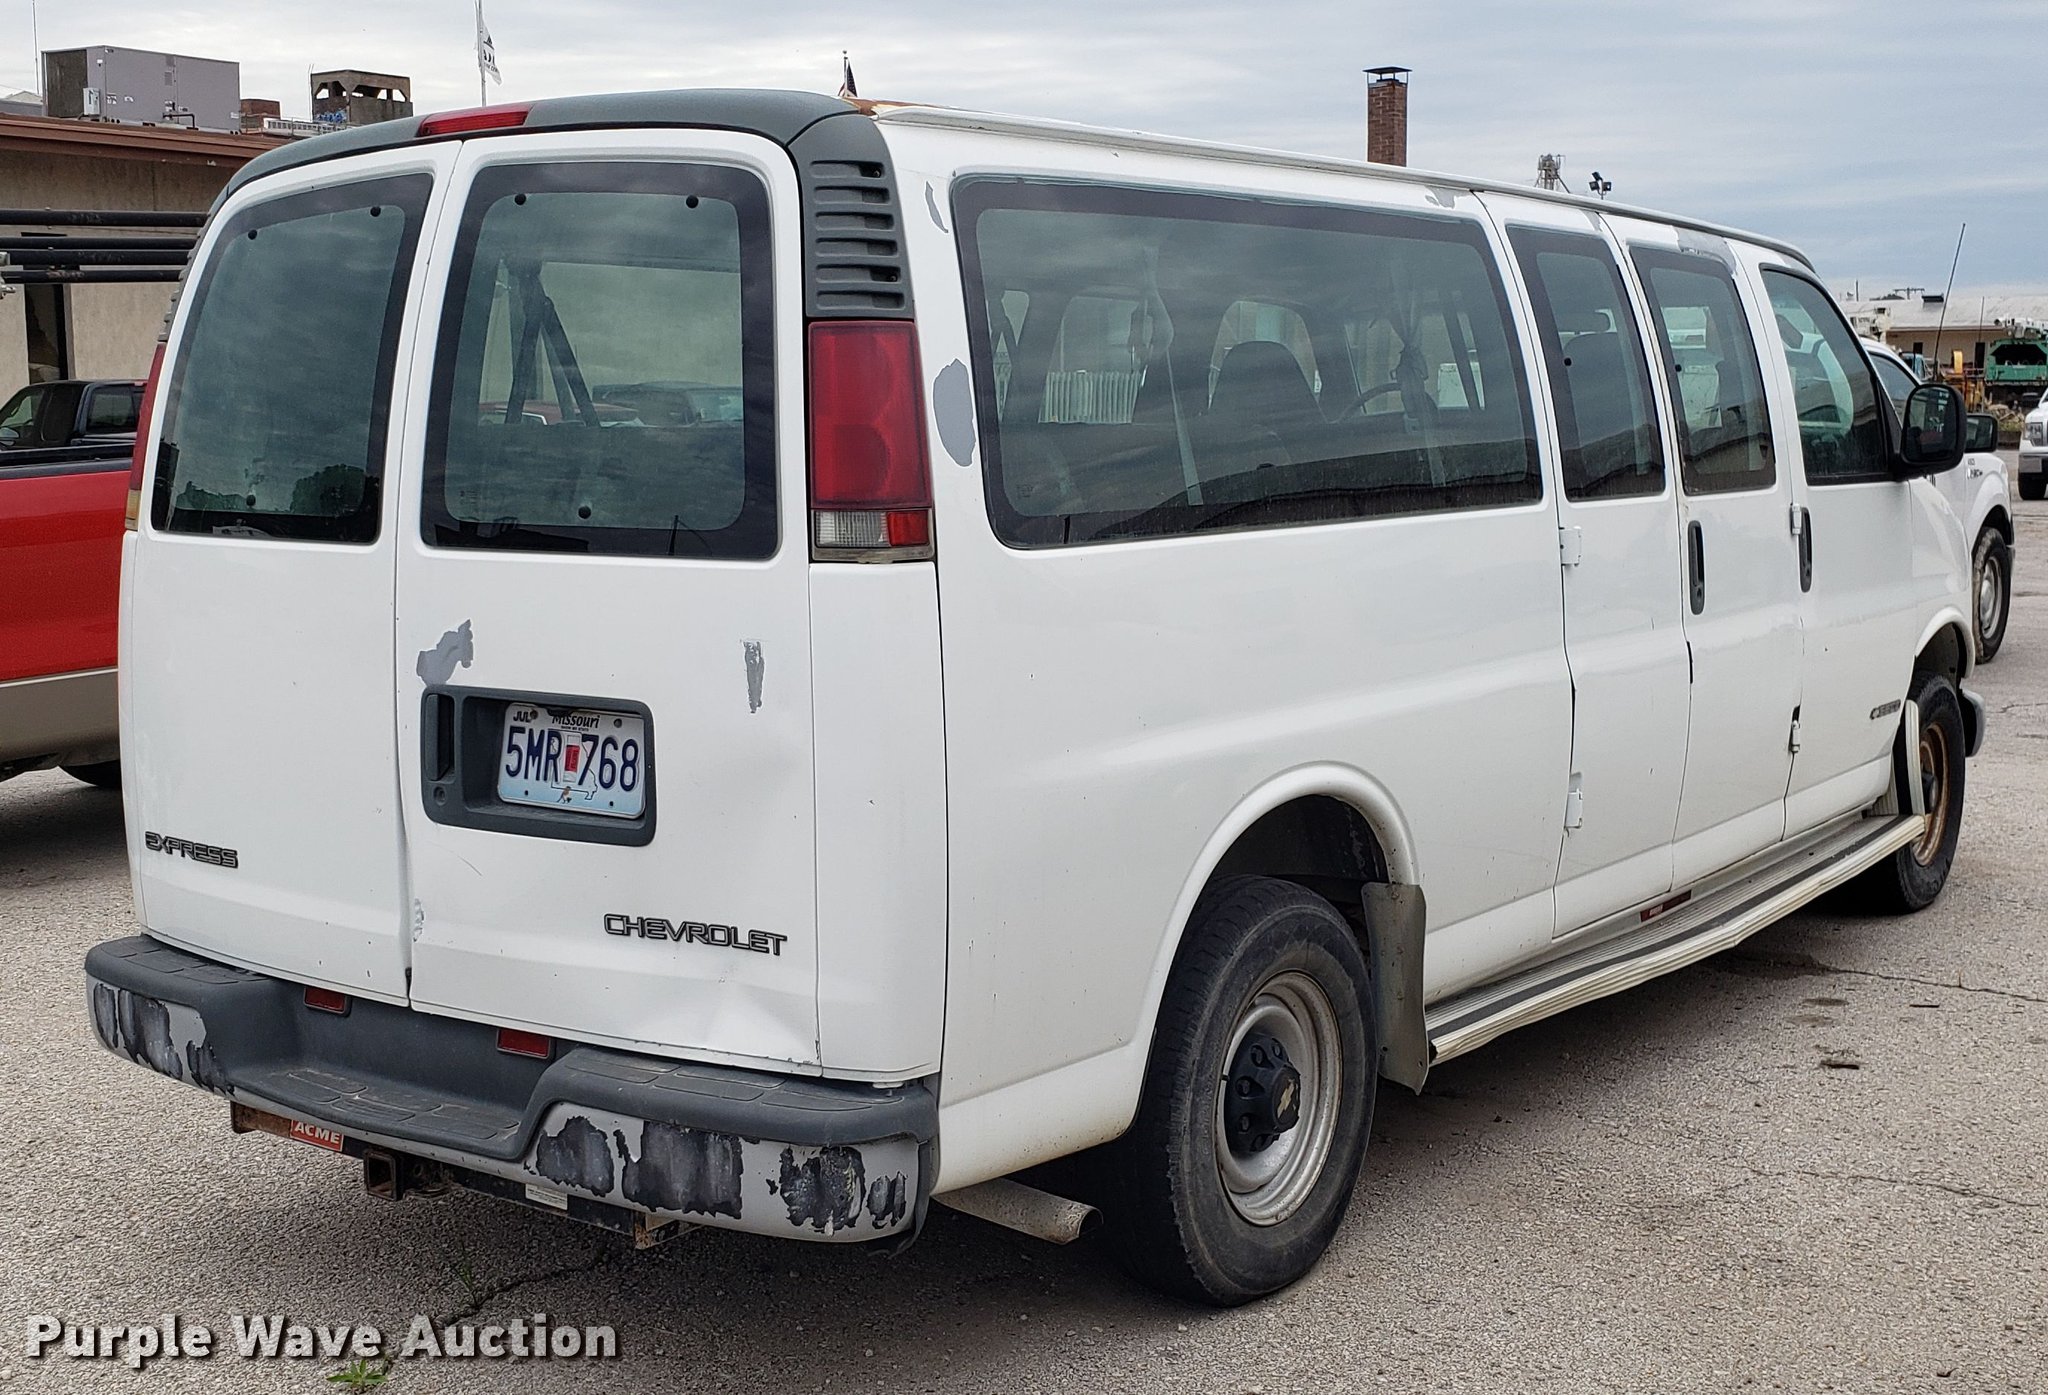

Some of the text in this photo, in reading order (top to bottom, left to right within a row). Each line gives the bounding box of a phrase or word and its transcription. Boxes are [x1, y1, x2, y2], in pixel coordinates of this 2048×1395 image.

[513, 711, 531, 723] JUL
[552, 714, 600, 728] Missouri
[506, 726, 639, 792] 5MR 768
[145, 831, 238, 869] EXPRESS
[604, 914, 787, 956] CHEVROLET
[294, 1122, 340, 1144] ACME
